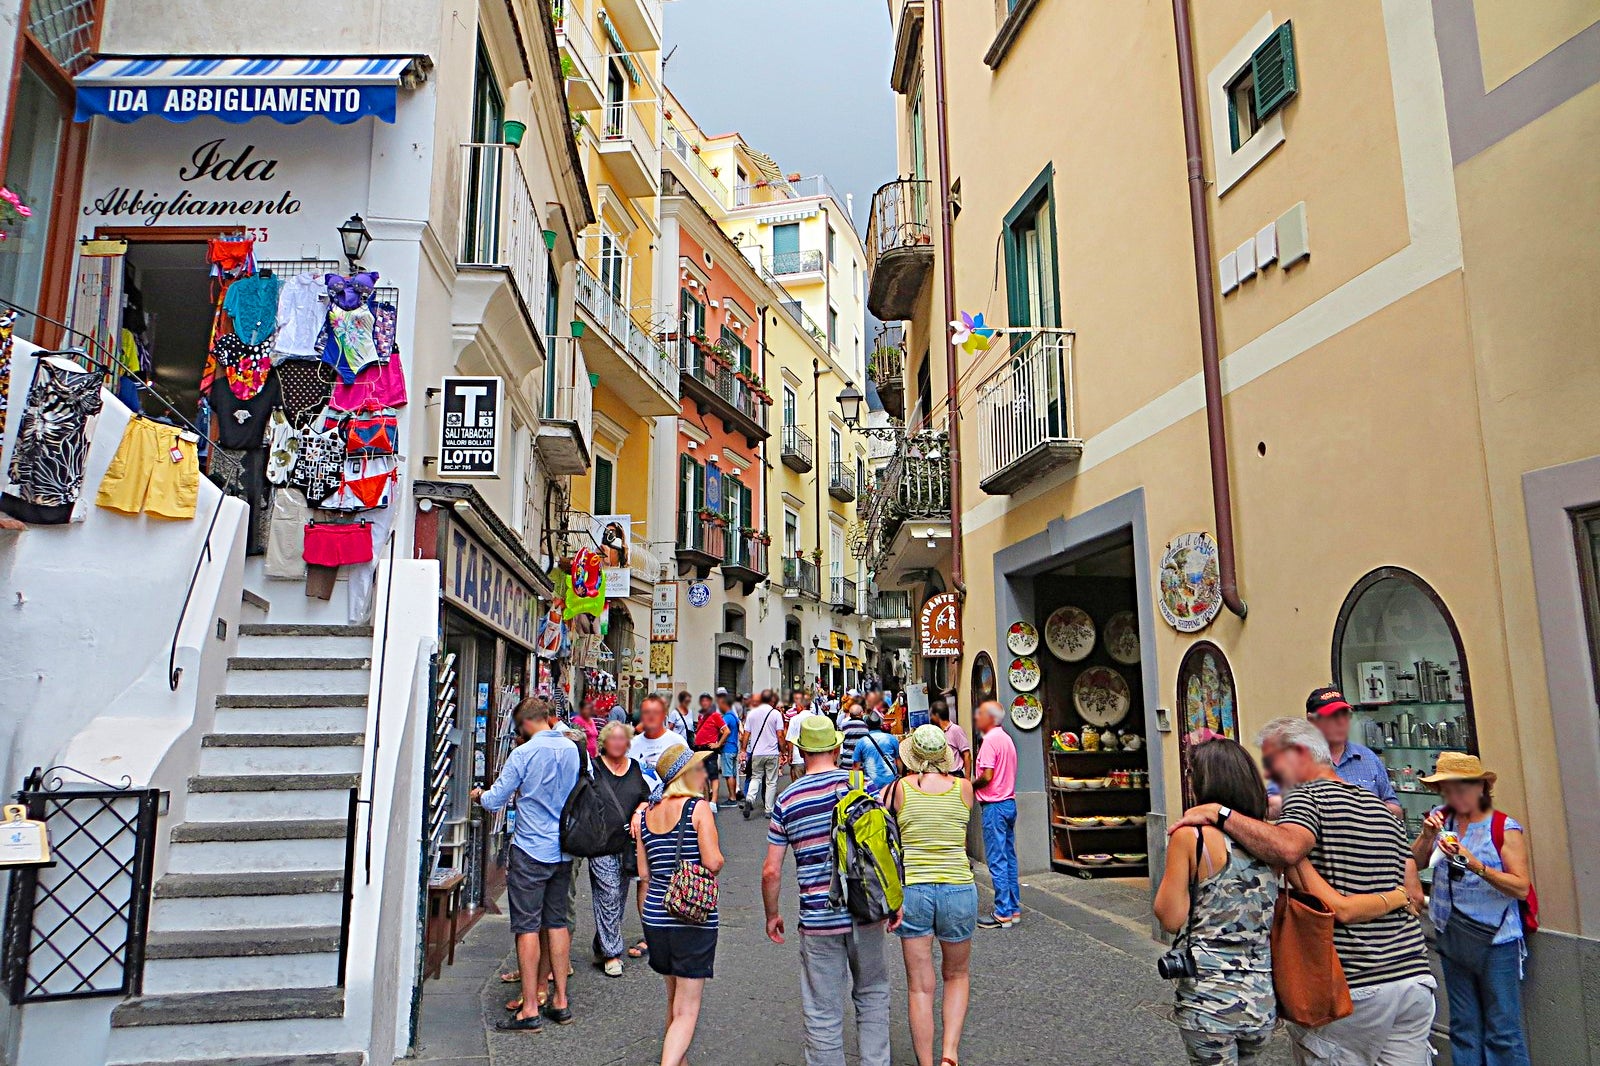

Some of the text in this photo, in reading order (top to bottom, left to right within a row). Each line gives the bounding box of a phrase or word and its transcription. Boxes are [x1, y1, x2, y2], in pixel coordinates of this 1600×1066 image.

[108, 87, 361, 114] IDA ABBIGLIAMENTO
[178, 138, 279, 183] Ida
[82, 186, 302, 227] Abbigliamento
[455, 386, 487, 427] T
[484, 417, 490, 426] 3
[445, 428, 494, 439] SALI TABACCHI
[444, 449, 493, 464] LOTTO
[453, 528, 535, 644] TABACCHI
[921, 594, 954, 648] RISTORANTE
[948, 605, 956, 630] BAR
